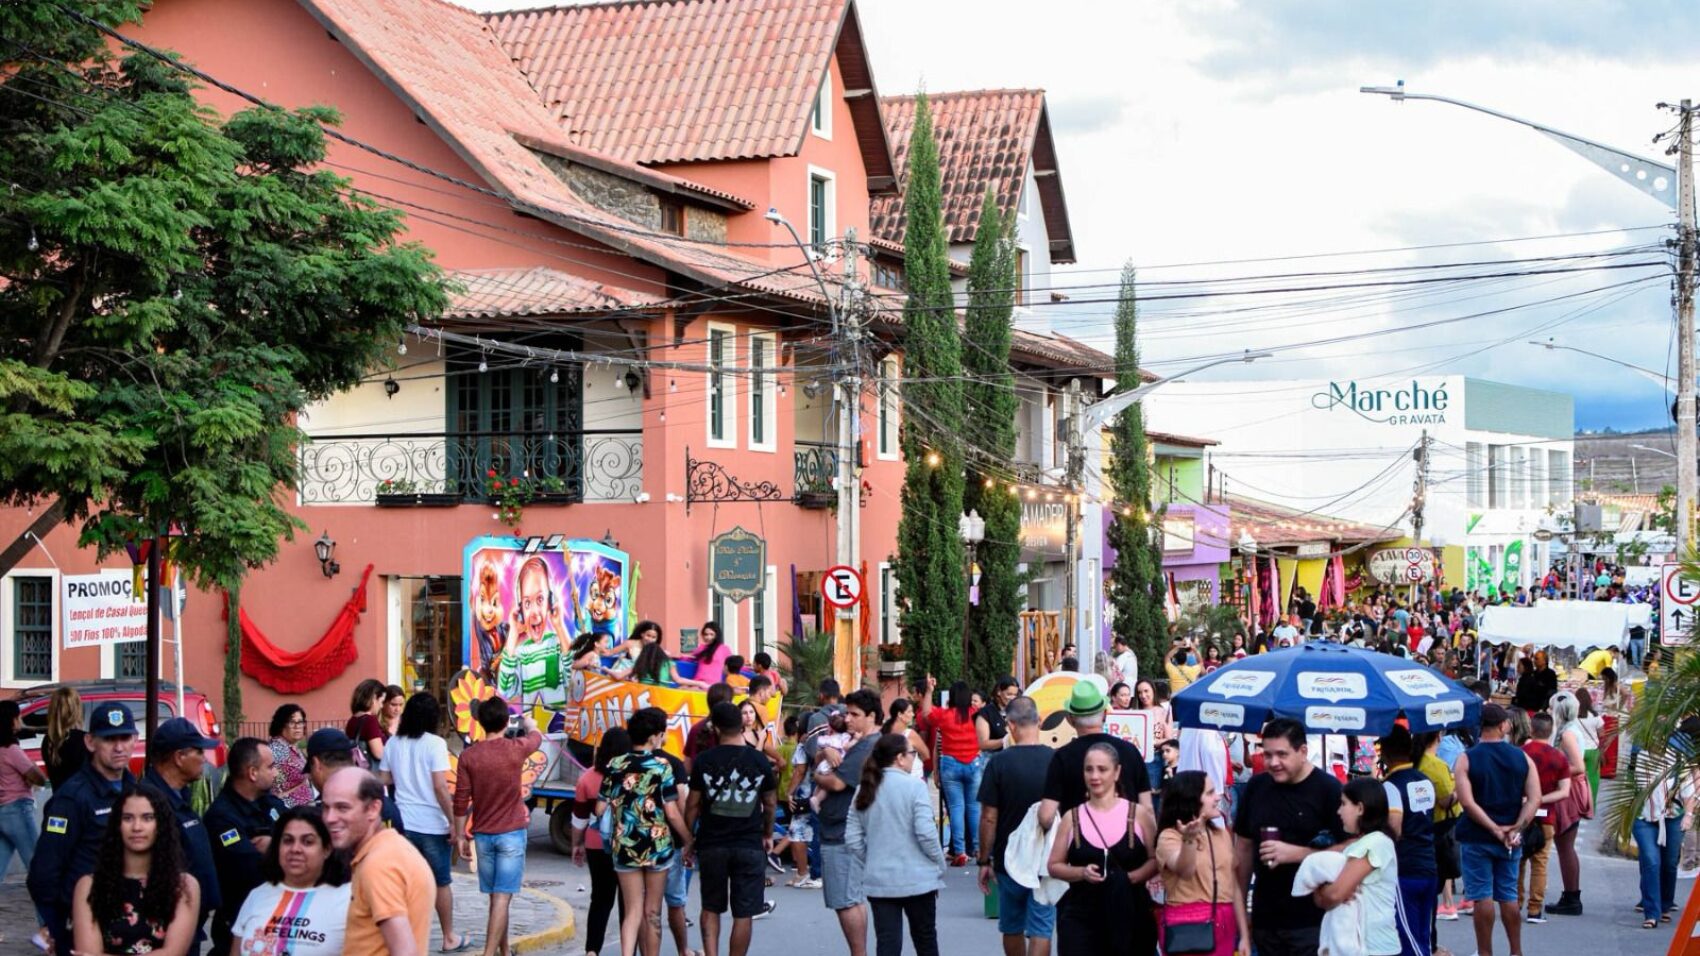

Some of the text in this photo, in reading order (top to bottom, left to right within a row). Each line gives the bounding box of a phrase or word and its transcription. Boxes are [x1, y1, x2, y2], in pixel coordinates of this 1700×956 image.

[1312, 380, 1448, 413] Marché
[1389, 412, 1446, 425] GRAVATÁ
[1377, 550, 1429, 562] TAVAS
[68, 579, 148, 599] PROMOÇ
[836, 575, 851, 599] E
[95, 607, 105, 619] de
[106, 606, 128, 618] Casal
[129, 605, 148, 618] Quee
[84, 629, 99, 641] Fios
[102, 626, 121, 639] 100%
[269, 915, 311, 927] MIXED
[264, 925, 326, 943] FEELINGS
